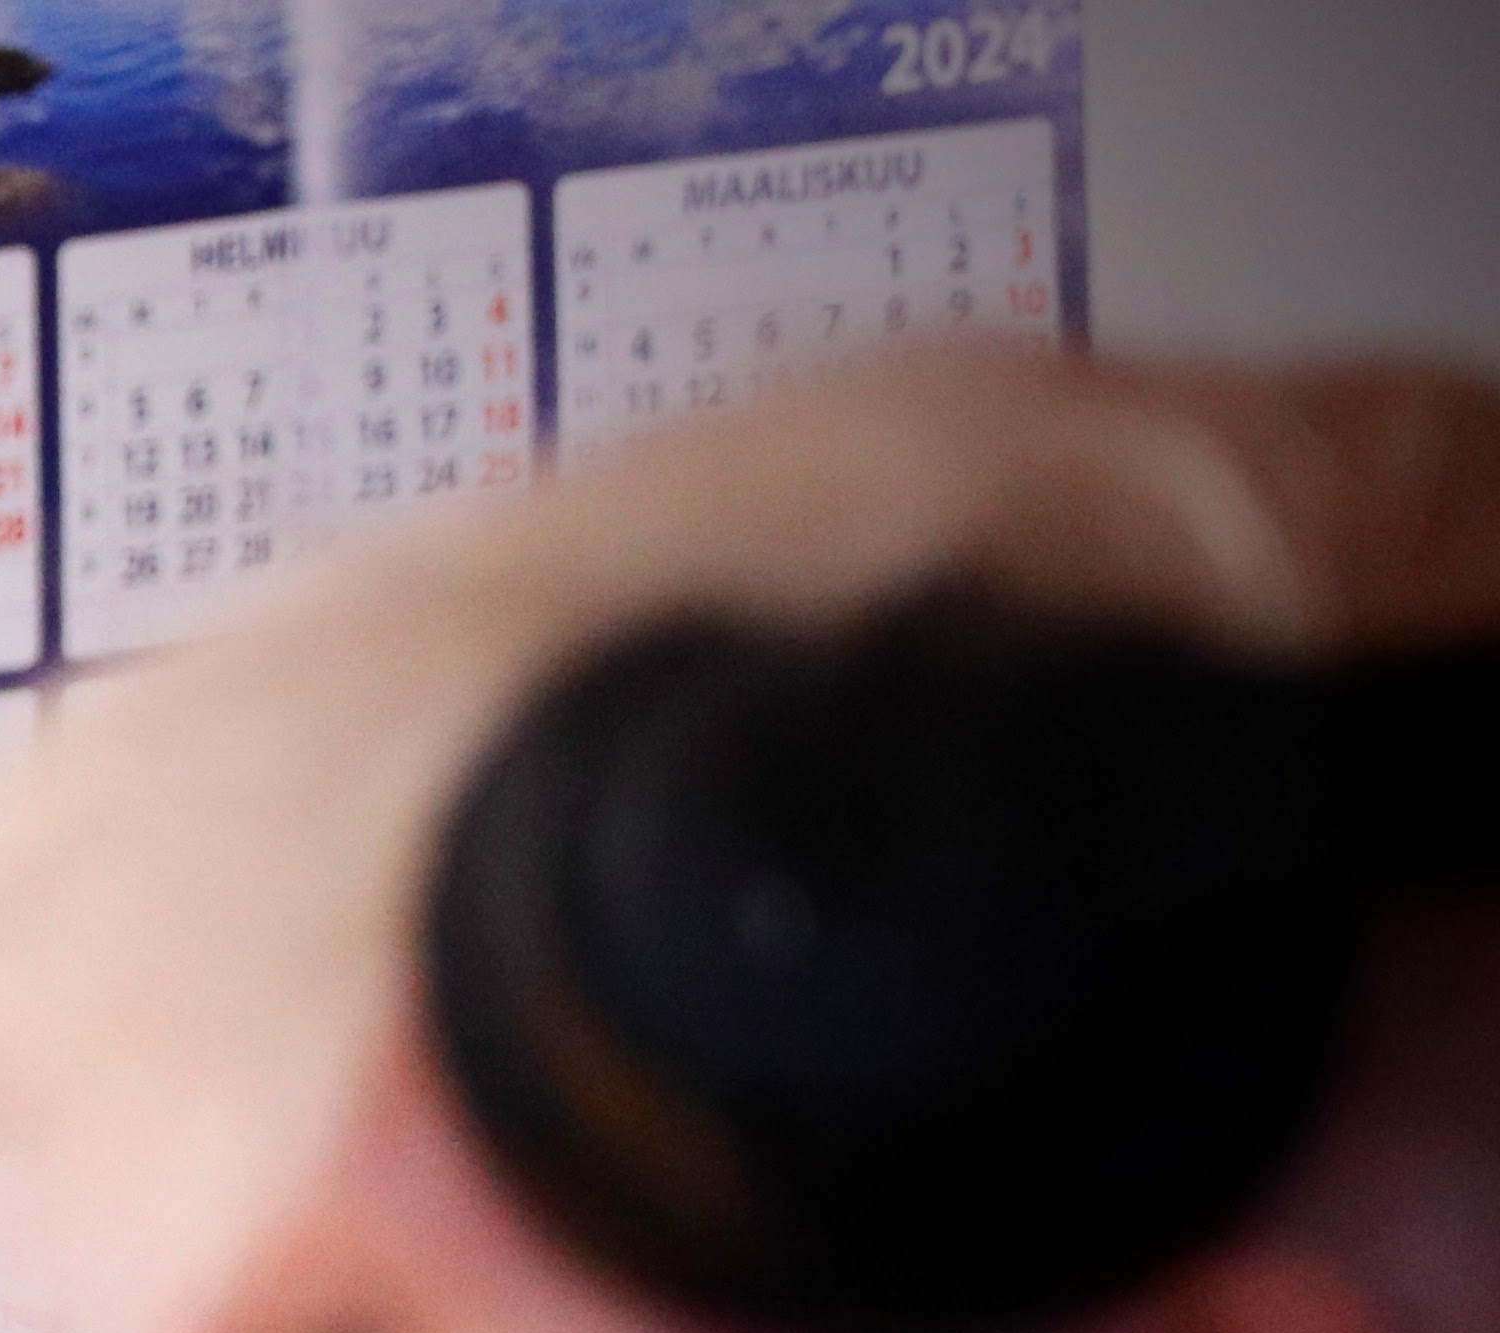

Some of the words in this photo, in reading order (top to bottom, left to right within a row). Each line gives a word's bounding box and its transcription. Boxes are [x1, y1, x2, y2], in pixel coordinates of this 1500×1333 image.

[881, 13, 1049, 95] 2024
[683, 150, 925, 212] MAALISKUU
[191, 219, 392, 272] HELMIUU
